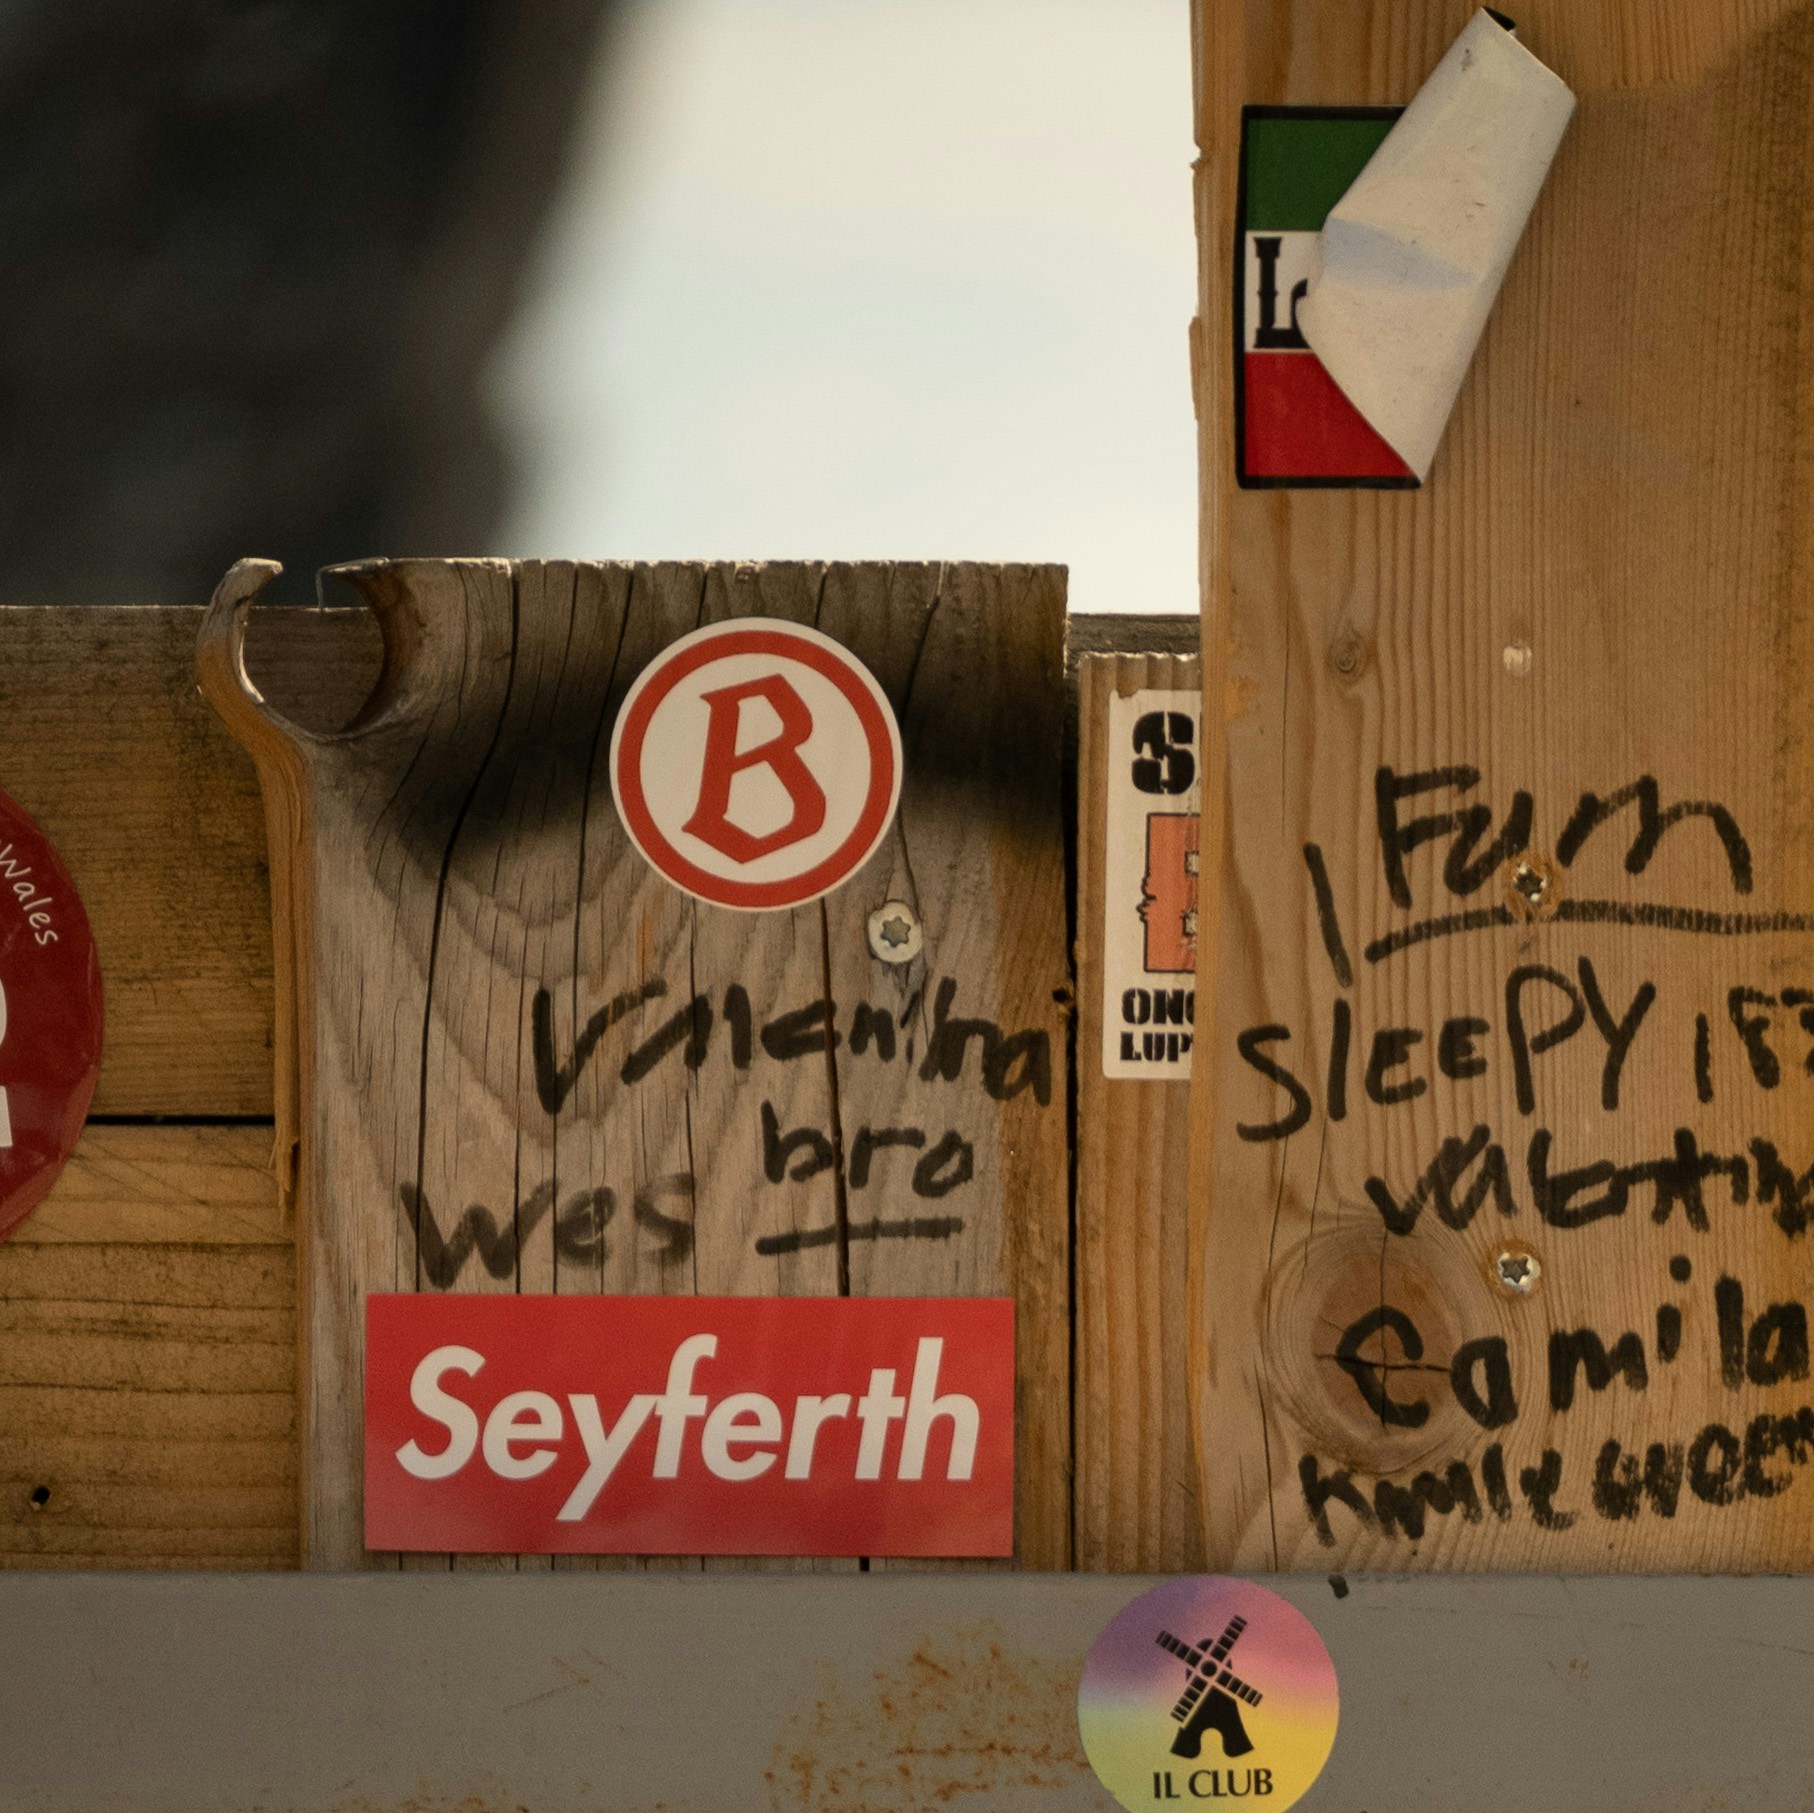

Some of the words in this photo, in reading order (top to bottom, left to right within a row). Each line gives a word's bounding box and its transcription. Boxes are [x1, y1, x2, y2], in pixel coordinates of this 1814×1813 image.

[0, 844, 60, 946] Wales
[395, 1333, 981, 1523] Seyferth
[1153, 1771, 1181, 1800] IL
[1187, 1767, 1274, 1798] CLUB
